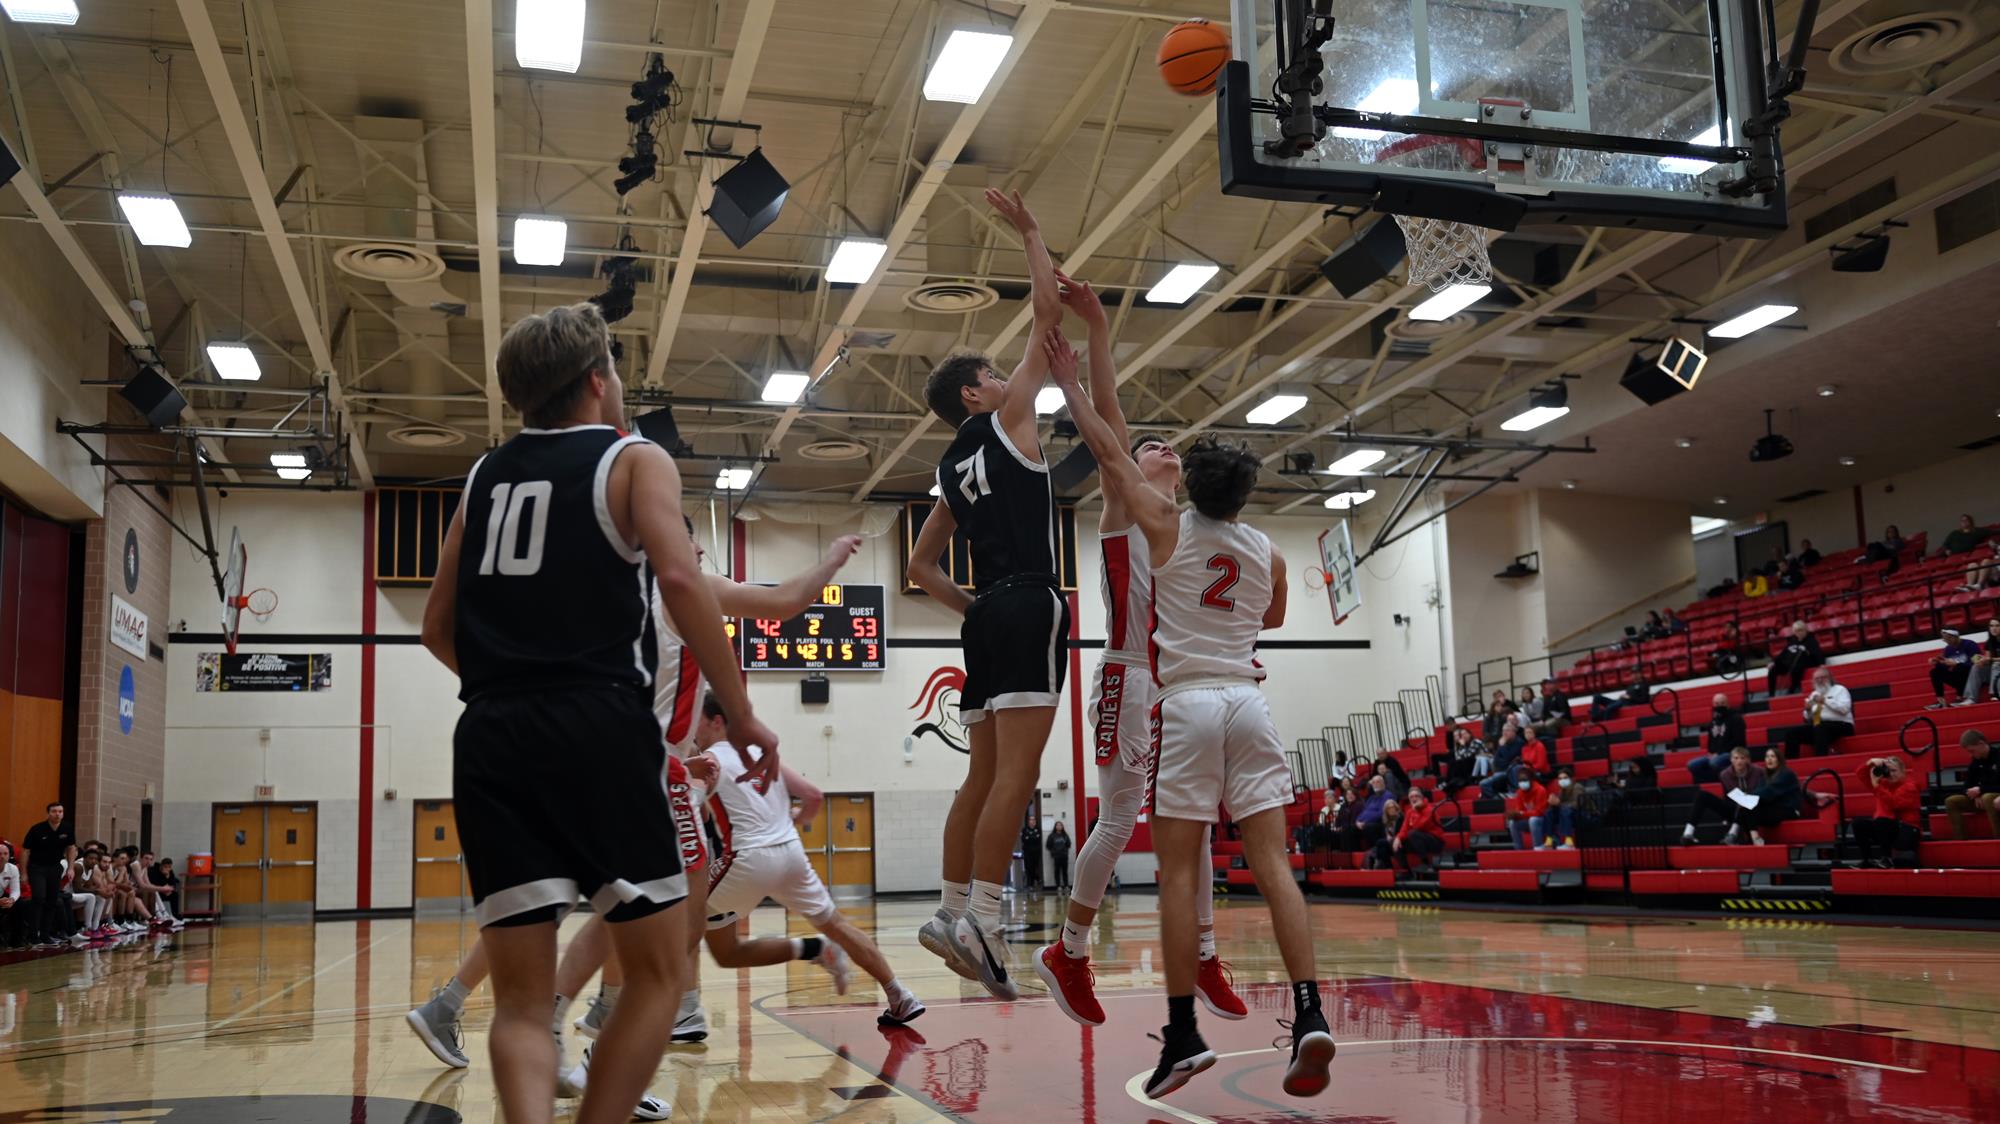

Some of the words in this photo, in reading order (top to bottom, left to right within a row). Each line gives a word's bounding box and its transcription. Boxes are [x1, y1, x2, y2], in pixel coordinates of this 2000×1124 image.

[955, 444, 992, 505] 21
[478, 480, 553, 576] 10
[823, 585, 842, 605] 10
[1200, 553, 1241, 612] 2
[115, 604, 145, 642] UMAC
[756, 619, 781, 637] 42
[808, 619, 821, 635] 2
[852, 618, 877, 637] 53
[849, 607, 875, 616] GUEST
[241, 663, 253, 671] BE
[253, 663, 288, 671] POSITIVE
[756, 644, 767, 660] 3
[776, 644, 788, 659] 4
[797, 644, 818, 660] 42
[826, 644, 833, 659] 1
[841, 644, 853, 660] 5
[867, 644, 877, 660] 3
[1098, 675, 1121, 758] RAIDERS
[671, 783, 700, 867] RAIDERS
